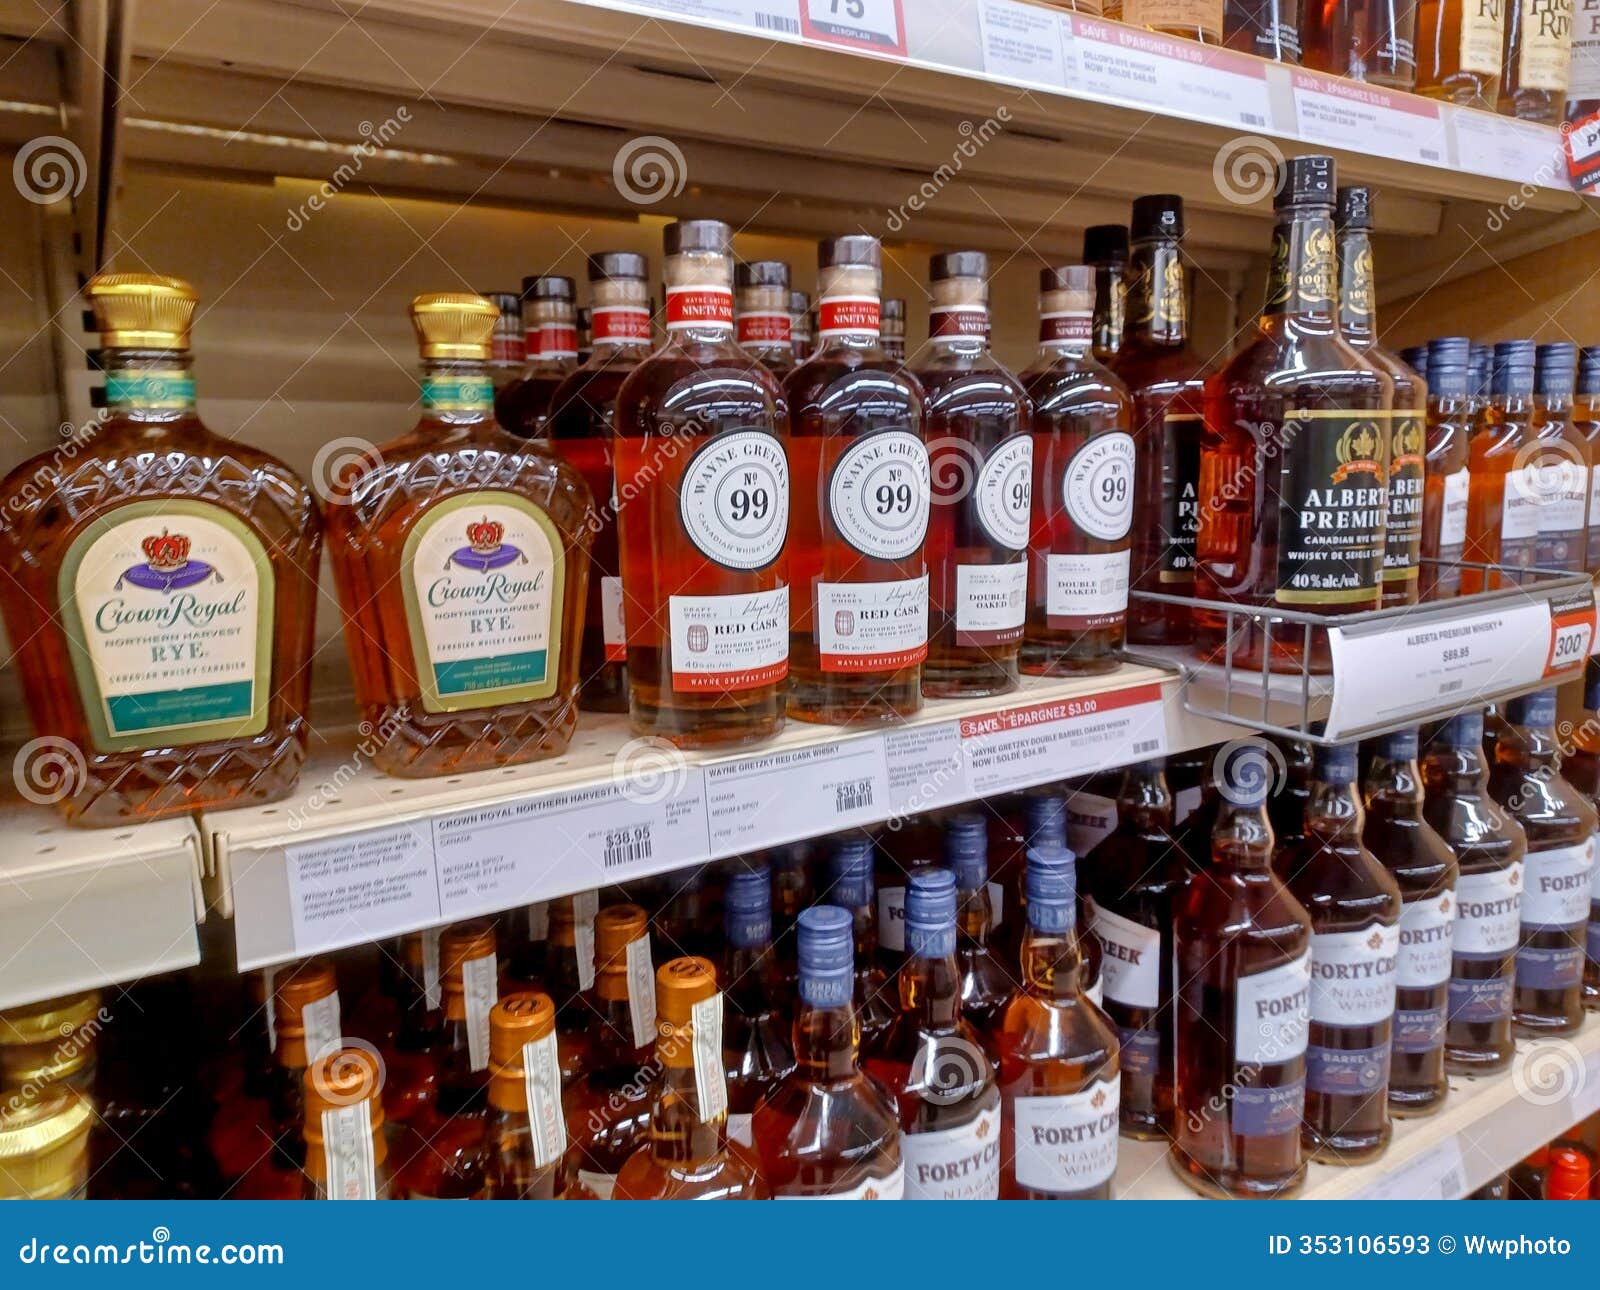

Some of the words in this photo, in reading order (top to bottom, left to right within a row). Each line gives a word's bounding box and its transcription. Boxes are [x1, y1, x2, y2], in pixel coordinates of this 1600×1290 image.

[682, 305, 717, 316] NINETY
[834, 314, 865, 324] NINETY
[694, 447, 738, 494] WAYNE
[744, 443, 786, 489] GRETZKY
[843, 446, 884, 489] WAYNE
[888, 443, 928, 485] GRETZKY
[987, 449, 1018, 488] WAYNE
[1075, 447, 1106, 481] WAYNE
[876, 484, 912, 514] 99
[1012, 483, 1030, 510] 99
[1102, 477, 1127, 503] 99
[1304, 487, 1388, 508] ALBERT
[730, 488, 769, 521] 99
[846, 506, 878, 542] CANADIAN
[1300, 509, 1389, 529] PREMIU
[698, 512, 734, 552] CANADIAN
[1303, 535, 1354, 545] CANADIAN
[1287, 551, 1328, 560] WHISKY
[1330, 551, 1343, 560] DE
[428, 577, 488, 608] Crown
[476, 570, 544, 604] Royal
[1058, 580, 1096, 588] DOUBLE
[969, 593, 1008, 601] DOUBLE
[976, 600, 1007, 609] OAKED
[95, 596, 171, 634] Crown
[158, 590, 246, 629] Royal
[435, 609, 493, 620] NORTHERN
[495, 603, 541, 614] HARVEST
[860, 609, 889, 620] RED
[894, 605, 920, 617] CASK
[471, 615, 512, 634] RYE
[715, 623, 746, 634] RED
[751, 617, 778, 632] CASK
[1407, 633, 1438, 647] ALBERTA
[1438, 627, 1472, 642] PREMIUM
[1472, 621, 1497, 635] WHISKY
[104, 633, 180, 648] NORTHERN
[183, 627, 241, 640] HARVEST
[1555, 633, 1581, 657] 300
[152, 640, 203, 663] RYE
[837, 658, 864, 667] WAYNE
[691, 676, 719, 686] WAYNE
[724, 674, 759, 685] GRETZKY
[970, 718, 998, 734] SAVE
[1010, 705, 1066, 727] ÉPARGNEZ
[1068, 700, 1097, 716] $3.00
[971, 746, 998, 758] WAYNE
[998, 740, 1029, 752] GRETZKY
[1031, 734, 1058, 745] DOUBLE
[1058, 728, 1083, 740] BARREL
[1084, 724, 1106, 735] OAKED
[1107, 719, 1131, 731] WHISKY
[709, 766, 737, 778] WAYNE
[738, 758, 774, 772] GRETZKY
[775, 755, 791, 766] RED
[792, 752, 811, 763] CASK
[813, 745, 840, 758] WHISKY
[972, 757, 992, 769] NOW
[836, 781, 872, 799] $36.95
[438, 816, 478, 831] CROWN
[480, 807, 513, 821] ROYAL
[516, 797, 569, 816] NORTHERN
[570, 787, 611, 805] HARVEST
[606, 826, 651, 848] $38.95
[1458, 898, 1513, 920] FORTY
[1399, 926, 1445, 946] ORTY
[1311, 961, 1374, 980] FORTY
[1031, 1121, 1098, 1146] FORTY
[917, 1153, 982, 1183] FORTY
